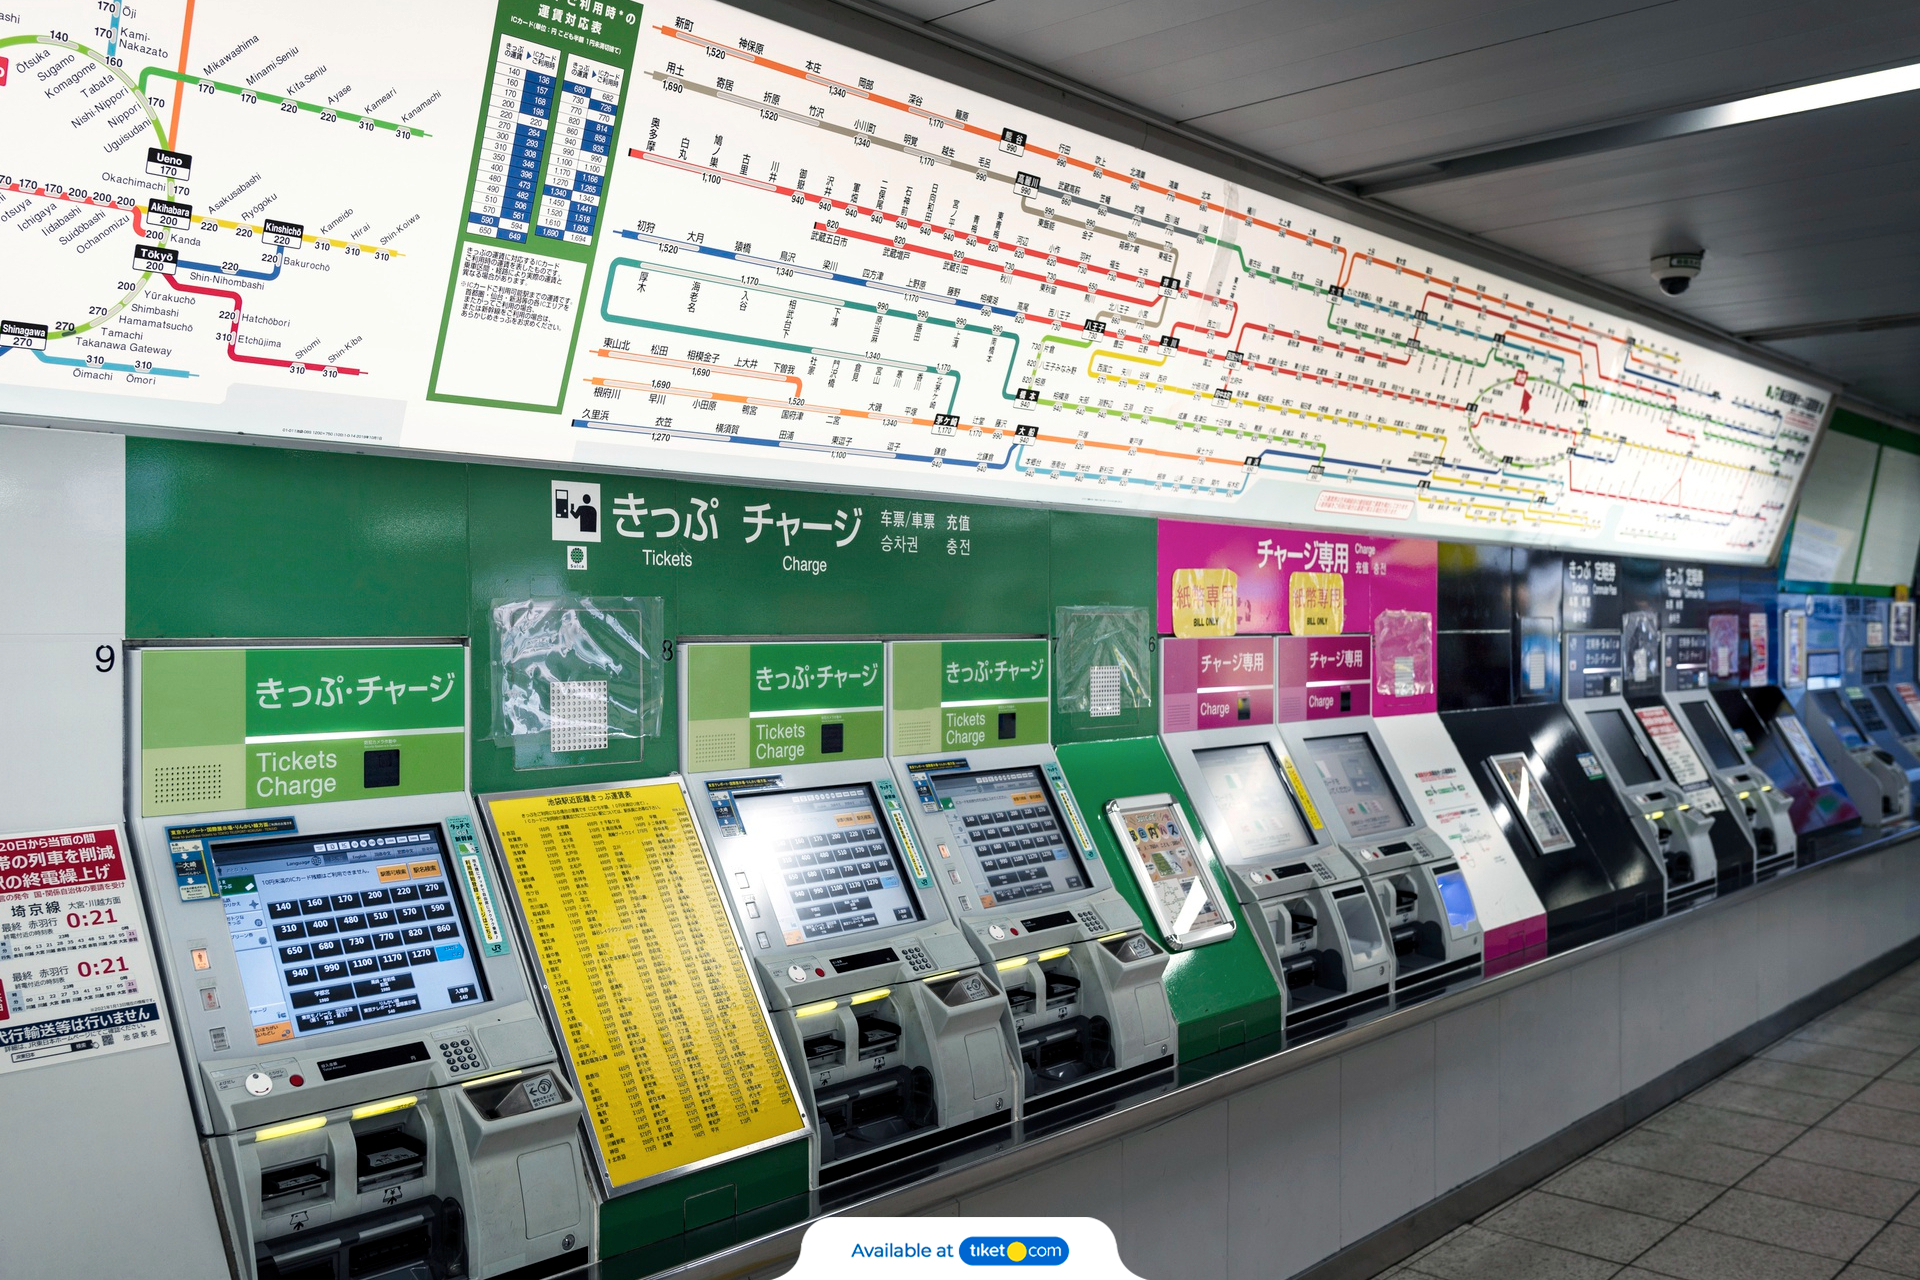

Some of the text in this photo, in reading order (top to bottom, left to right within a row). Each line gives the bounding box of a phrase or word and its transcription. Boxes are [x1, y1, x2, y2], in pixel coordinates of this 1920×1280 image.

[674, 16, 694, 32] 新町
[119, 39, 169, 59] Nakazato
[202, 34, 260, 77] Mikawashima
[705, 45, 726, 60] 1,520
[36, 53, 76, 83] Sugamo
[245, 45, 300, 86] Minami-Senju
[508, 67, 521, 76] 140
[44, 61, 97, 99] Komagome
[79, 73, 115, 99] Tabata
[285, 63, 328, 97] Kita-Senju
[326, 83, 352, 106] Ayase
[364, 86, 398, 115] Kameari
[70, 85, 129, 129] Nishi-Nippori
[107, 100, 142, 129] Nippori
[400, 89, 442, 124] Kanamachi
[103, 117, 152, 155] Uguisudani
[156, 152, 183, 166] Ueno
[101, 172, 167, 192] Okachimachi
[207, 171, 263, 216] Asakusabashi
[17, 202, 58, 232] Ichigaya
[150, 202, 190, 218] Akihabara
[41, 205, 82, 237] Iidabashi
[319, 207, 354, 236] Kameido
[379, 212, 421, 247] Shin-Koiwa
[481, 216, 494, 225] 590
[76, 215, 130, 255] Ochanomizu
[170, 234, 201, 247] Kanda
[350, 222, 371, 241] Hirai
[686, 231, 705, 244] 大月
[189, 271, 265, 291] Shin-Nihombashi
[636, 271, 649, 293] 厚木
[131, 303, 180, 318] Shimbashi
[2, 323, 46, 338] Shinagawa
[75, 336, 172, 356] Takanawa Gateway
[327, 334, 364, 364] Shin-Kiba
[603, 337, 631, 351] 東山北
[733, 357, 758, 369] 上大井
[593, 387, 621, 400] 根府川
[581, 408, 610, 421] 久里浜
[651, 432, 671, 443] 1,270
[613, 493, 863, 548] きっぷ チャージ
[880, 509, 970, 532] 车票/車票 充值
[880, 535, 970, 556] 승차권 충전
[1355, 543, 1376, 557] Charge
[642, 549, 828, 576] Tickets Charge
[1257, 539, 1349, 574] チャージ専用
[1193, 617, 1219, 627] BILL ONLY
[1307, 617, 1328, 626] BILL ONLY
[662, 639, 673, 661] 8
[1149, 637, 1156, 653] 6
[95, 644, 116, 673] 9
[1201, 652, 1264, 674] チャージ専用
[1310, 650, 1363, 669] チャージ専用
[1200, 702, 1230, 717] Charge
[1309, 695, 1334, 710] Charge
[946, 713, 986, 728] Tickets
[756, 723, 805, 740] Tickets
[946, 729, 985, 746] Charge
[256, 750, 337, 773] Tickets
[756, 743, 805, 761] Charge
[256, 774, 336, 800] Charge
[11, 901, 61, 918] 埼京線
[275, 890, 383, 911] 140 160 170 200
[1, 908, 118, 933] 最終 赤羽行 0:21
[281, 920, 329, 933] 310 400
[286, 941, 334, 955] 650 680
[352, 949, 431, 968] 1100 1270
[12, 956, 129, 982] 最終 赤羽行 0:21
